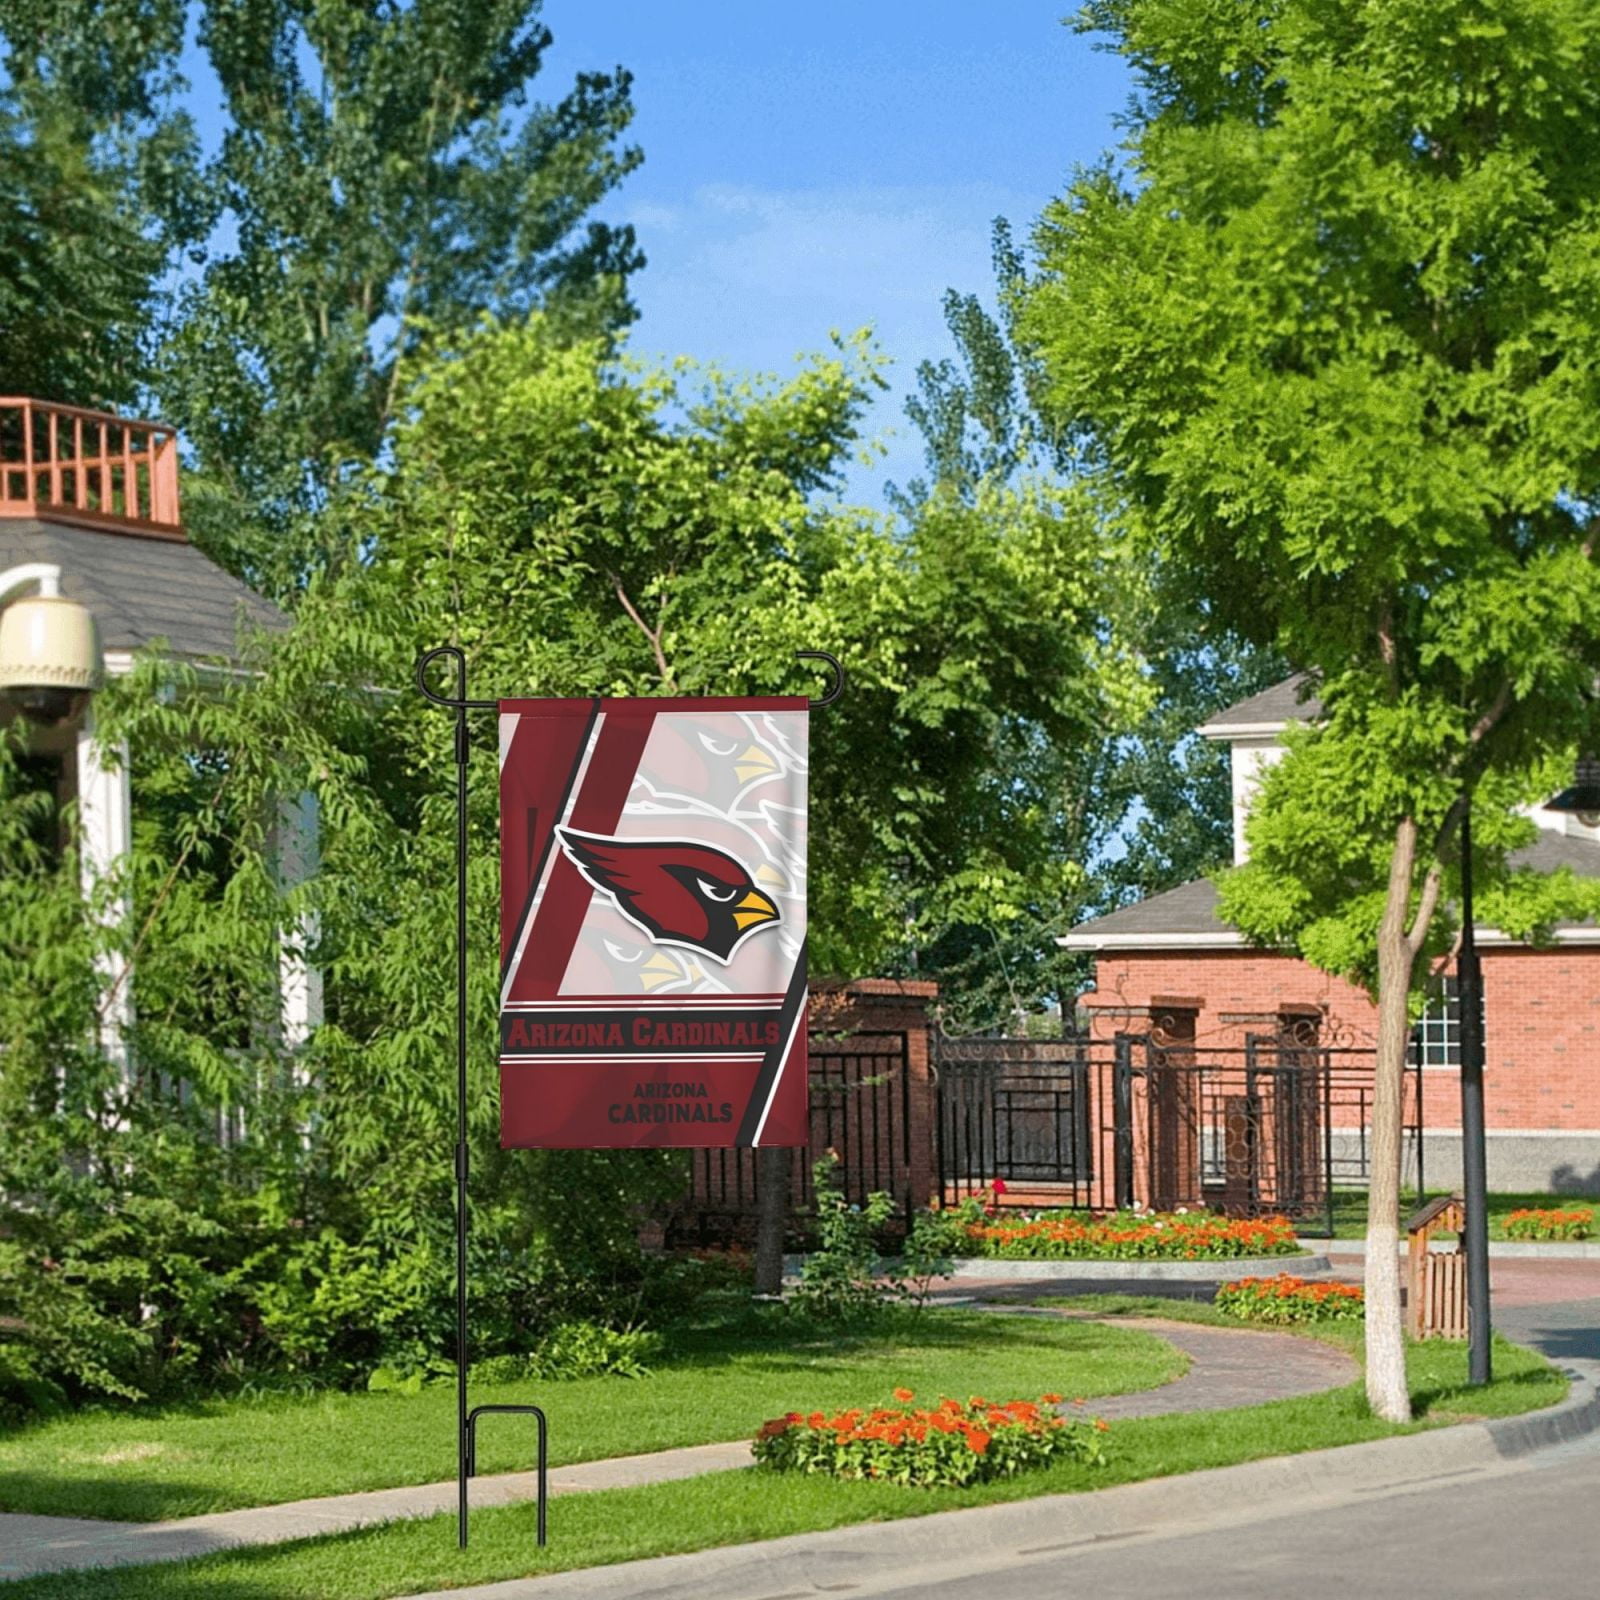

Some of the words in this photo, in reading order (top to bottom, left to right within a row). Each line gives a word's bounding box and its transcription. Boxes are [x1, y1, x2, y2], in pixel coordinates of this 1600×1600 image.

[507, 1018, 625, 1048] ARIZONA
[632, 1017, 781, 1046] CARDINALS
[633, 1083, 708, 1098] ARIZONA
[608, 1103, 733, 1124] CARDINALS
